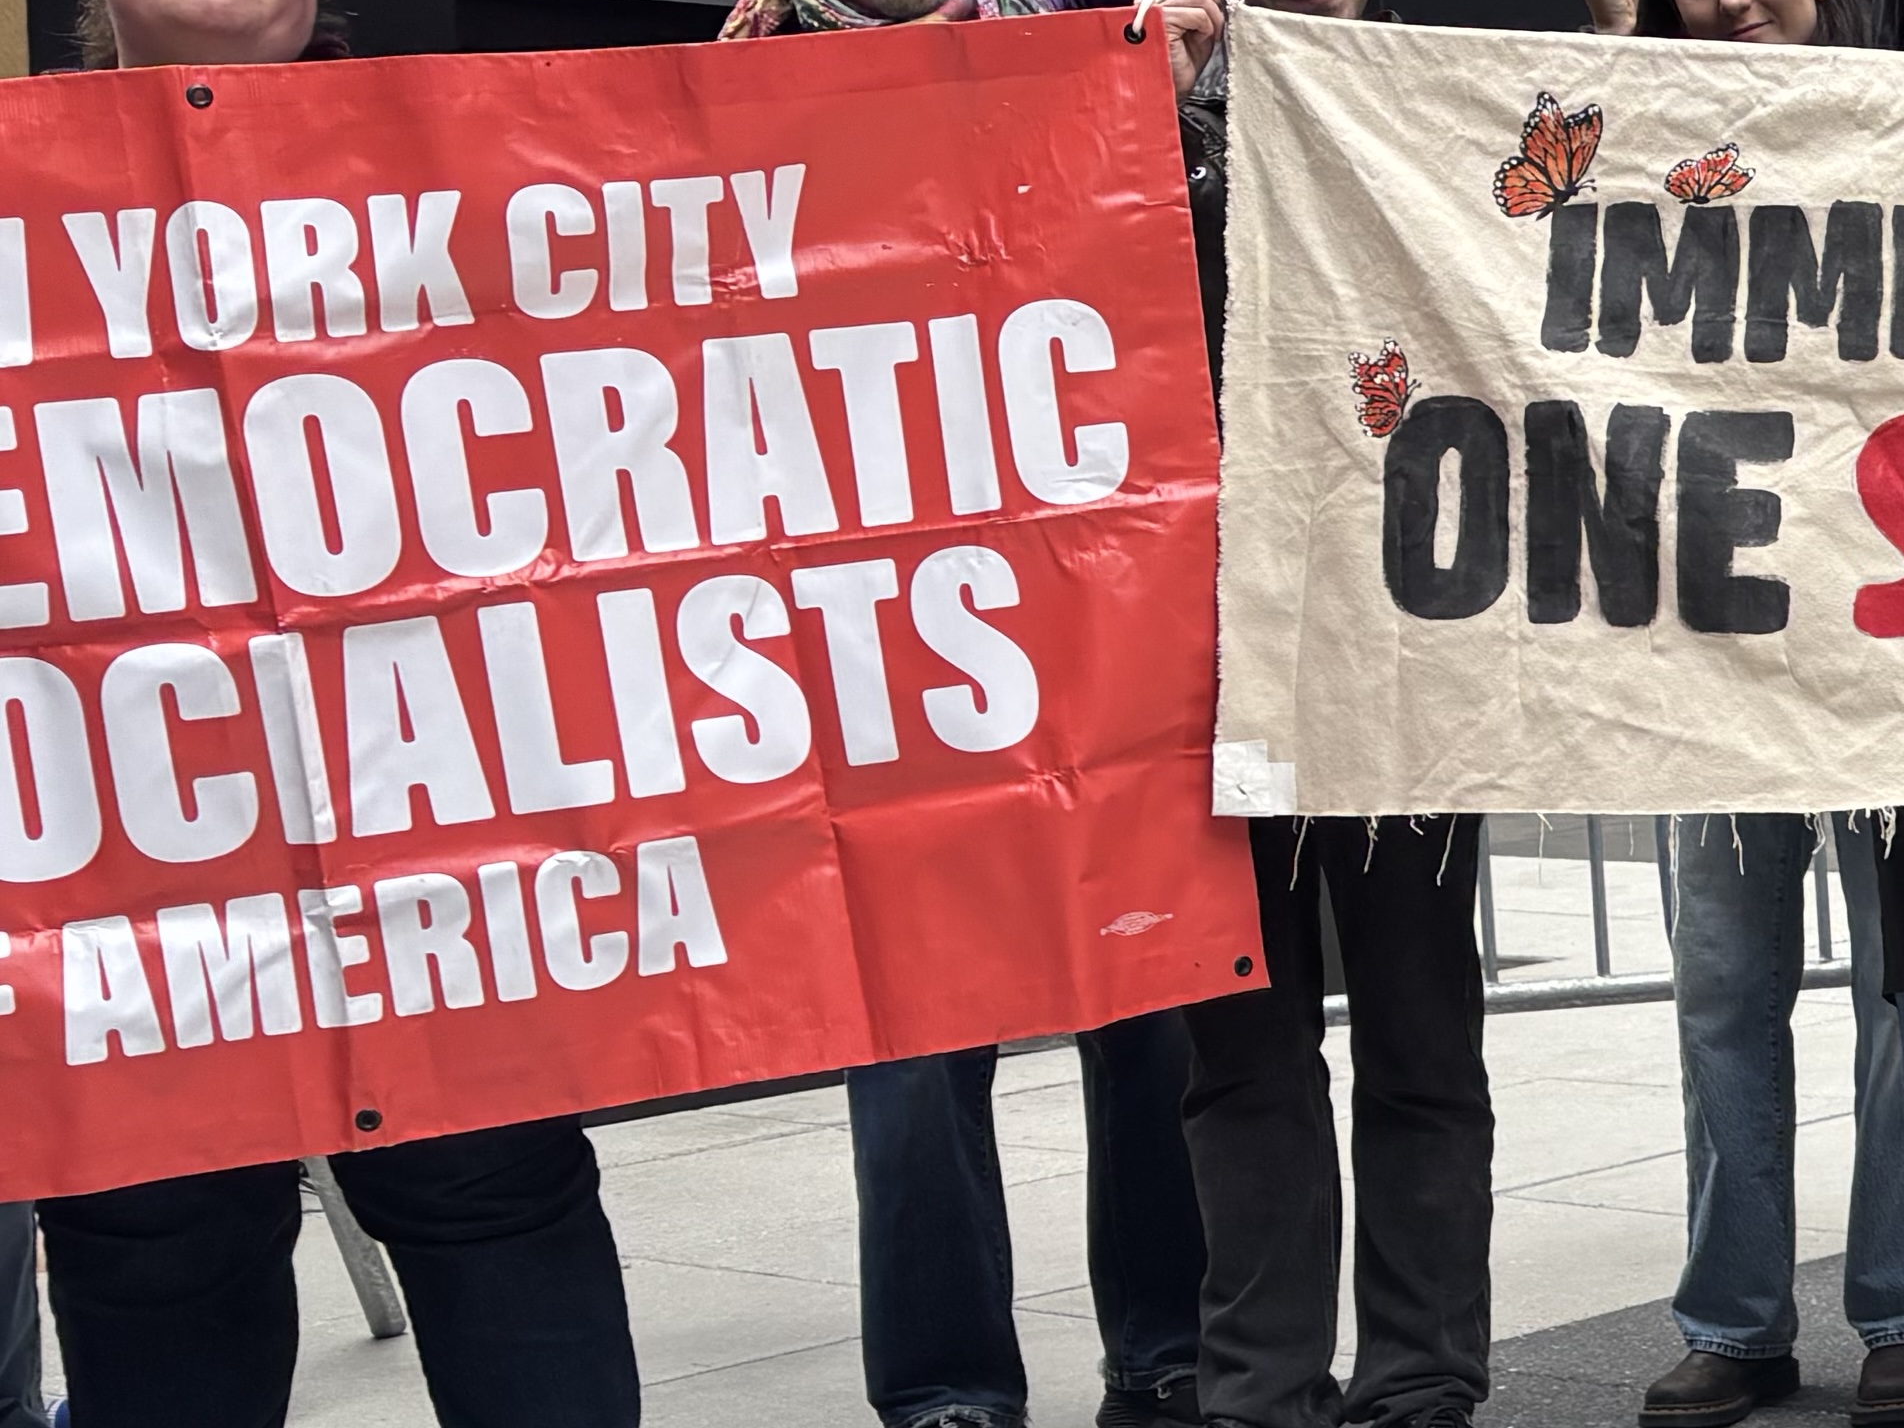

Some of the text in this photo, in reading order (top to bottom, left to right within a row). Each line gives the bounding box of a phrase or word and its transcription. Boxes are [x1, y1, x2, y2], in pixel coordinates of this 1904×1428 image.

[61, 188, 474, 360] YORK
[505, 163, 806, 321] CITY
[1383, 395, 1795, 635] ONE
[64, 836, 728, 1065] AMERICA
